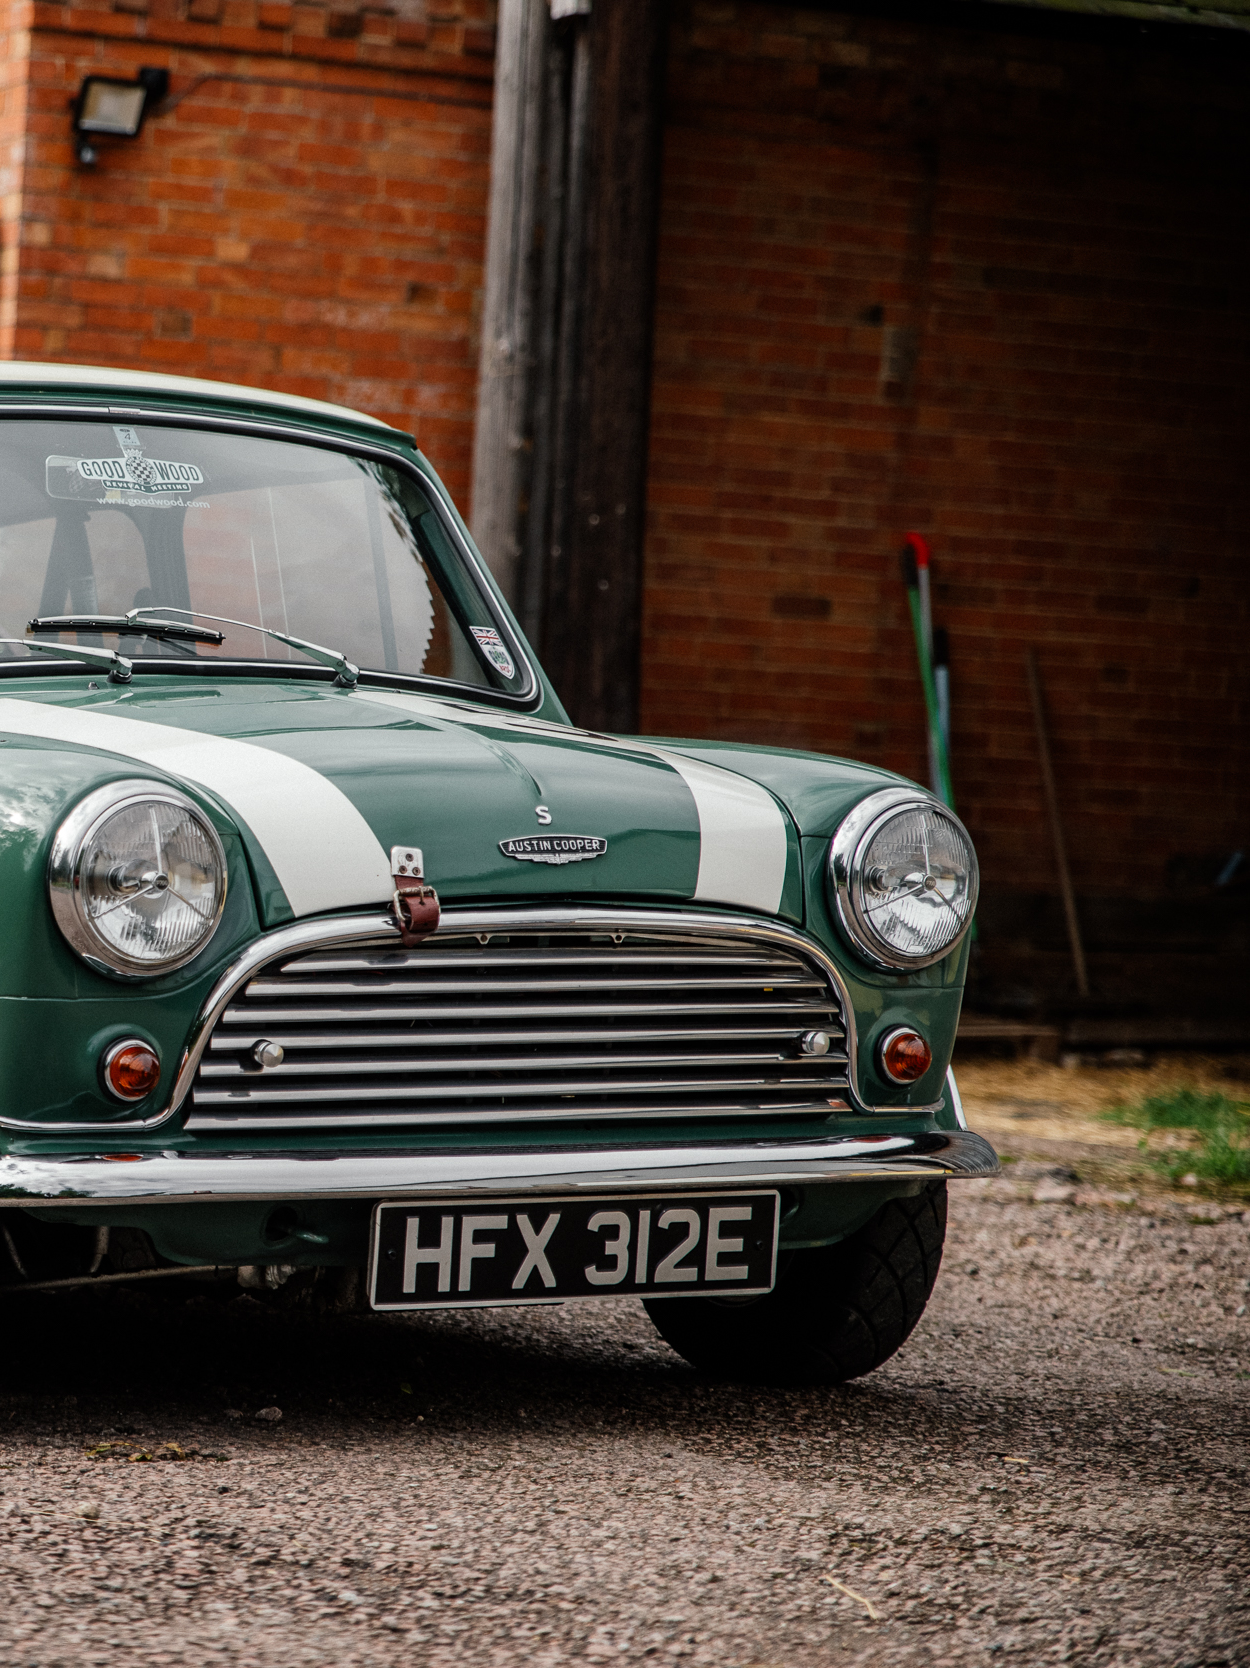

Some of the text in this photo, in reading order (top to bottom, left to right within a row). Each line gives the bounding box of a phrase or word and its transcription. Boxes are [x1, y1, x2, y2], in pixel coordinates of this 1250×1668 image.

[80, 460, 126, 479] GOOD
[152, 460, 200, 482] WOOD
[105, 480, 188, 492] REVIVAL MEETING
[96, 496, 211, 509] www.goodwood.com
[535, 805, 552, 825] S
[507, 839, 601, 852] AUSTIN COOPER
[402, 1206, 753, 1294] HFX 312E
